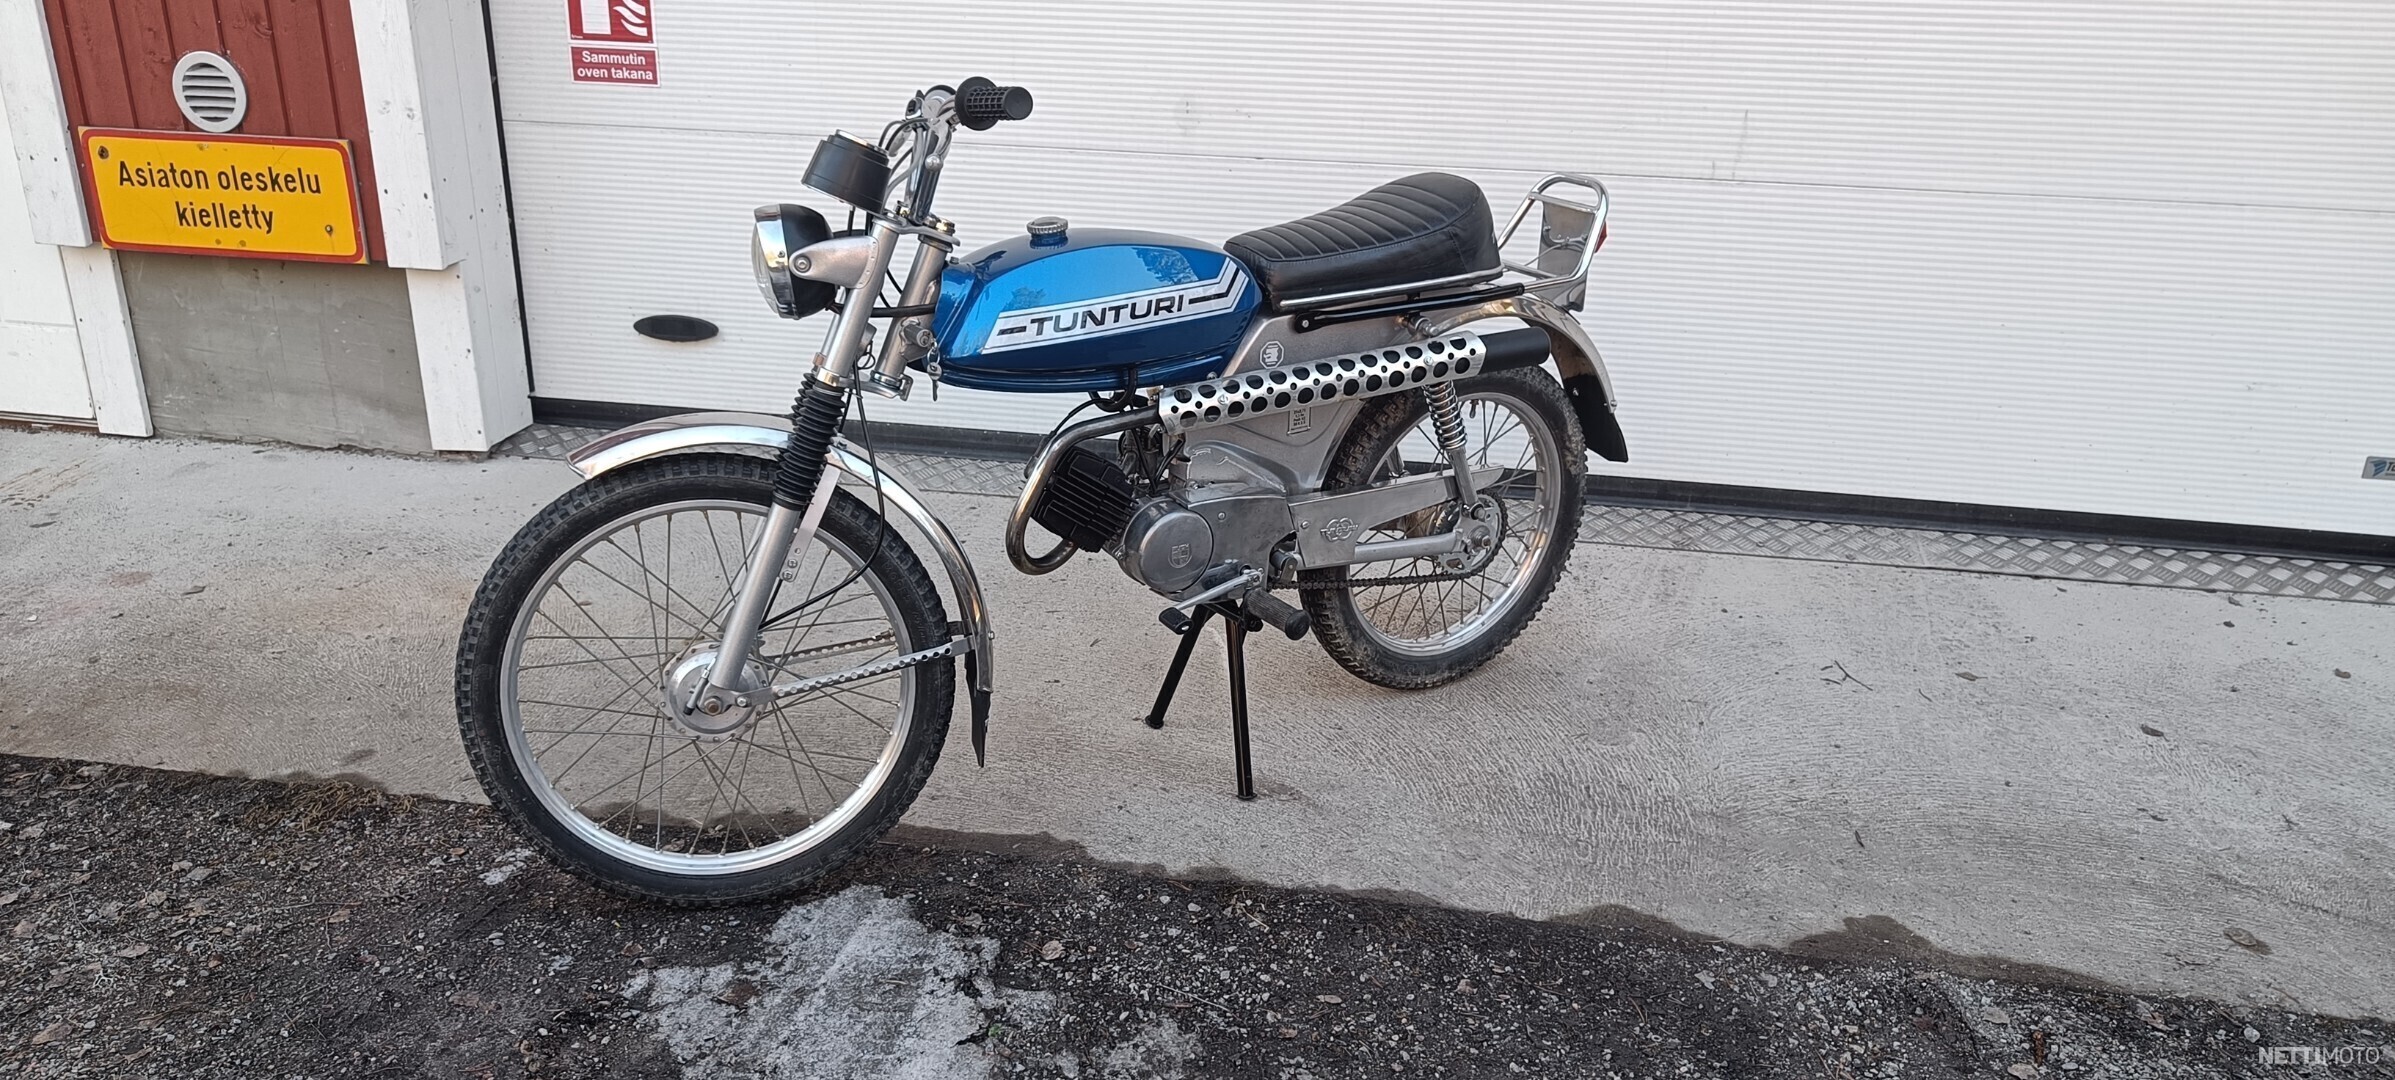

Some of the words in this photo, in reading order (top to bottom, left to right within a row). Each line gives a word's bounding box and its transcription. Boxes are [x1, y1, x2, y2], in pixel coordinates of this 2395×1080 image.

[577, 67, 608, 78] oven
[611, 67, 653, 80] takana
[582, 51, 646, 65] Sammutin
[119, 161, 209, 190] Asiaton
[217, 165, 321, 194] oleskelu
[175, 201, 273, 234] kielletty
[1030, 294, 1184, 336] TUNTURI
